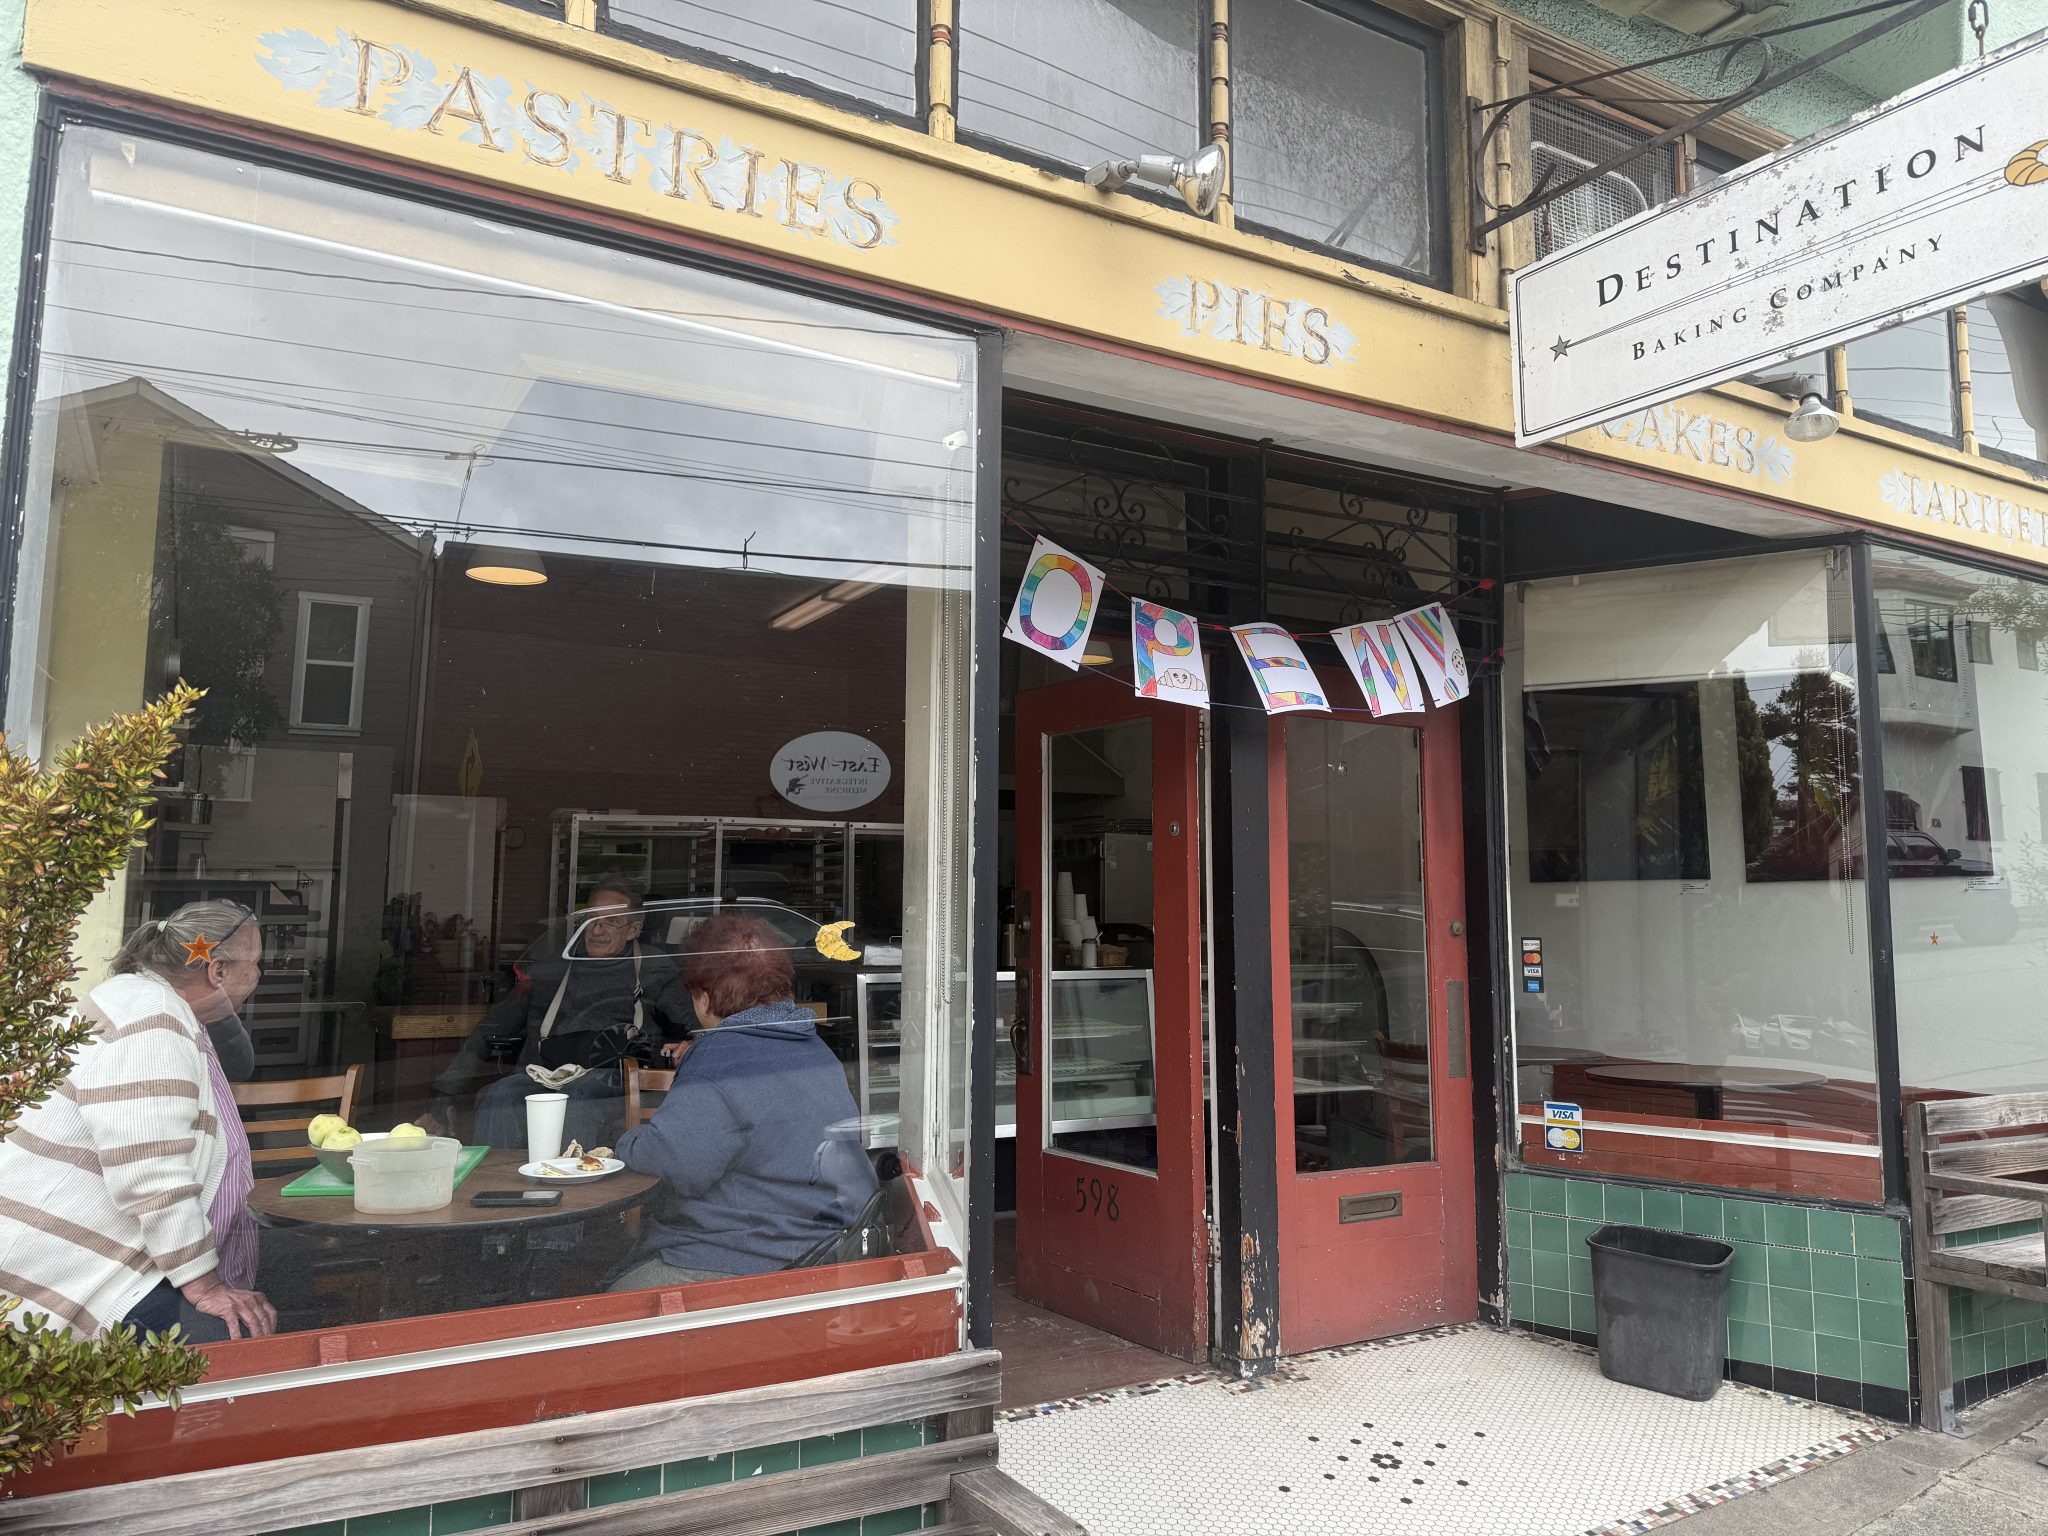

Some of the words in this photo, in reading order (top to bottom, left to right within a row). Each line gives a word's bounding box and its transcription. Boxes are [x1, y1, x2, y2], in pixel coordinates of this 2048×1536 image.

[345, 33, 886, 250] PASTRIES
[1595, 125, 1986, 307] DESTINATION
[1186, 273, 1331, 365] PIES
[1632, 306, 1748, 361] BAKING
[1769, 234, 1943, 309] COMPANY
[1552, 1109, 1574, 1120] VISA
[1076, 1177, 1120, 1222] 598
